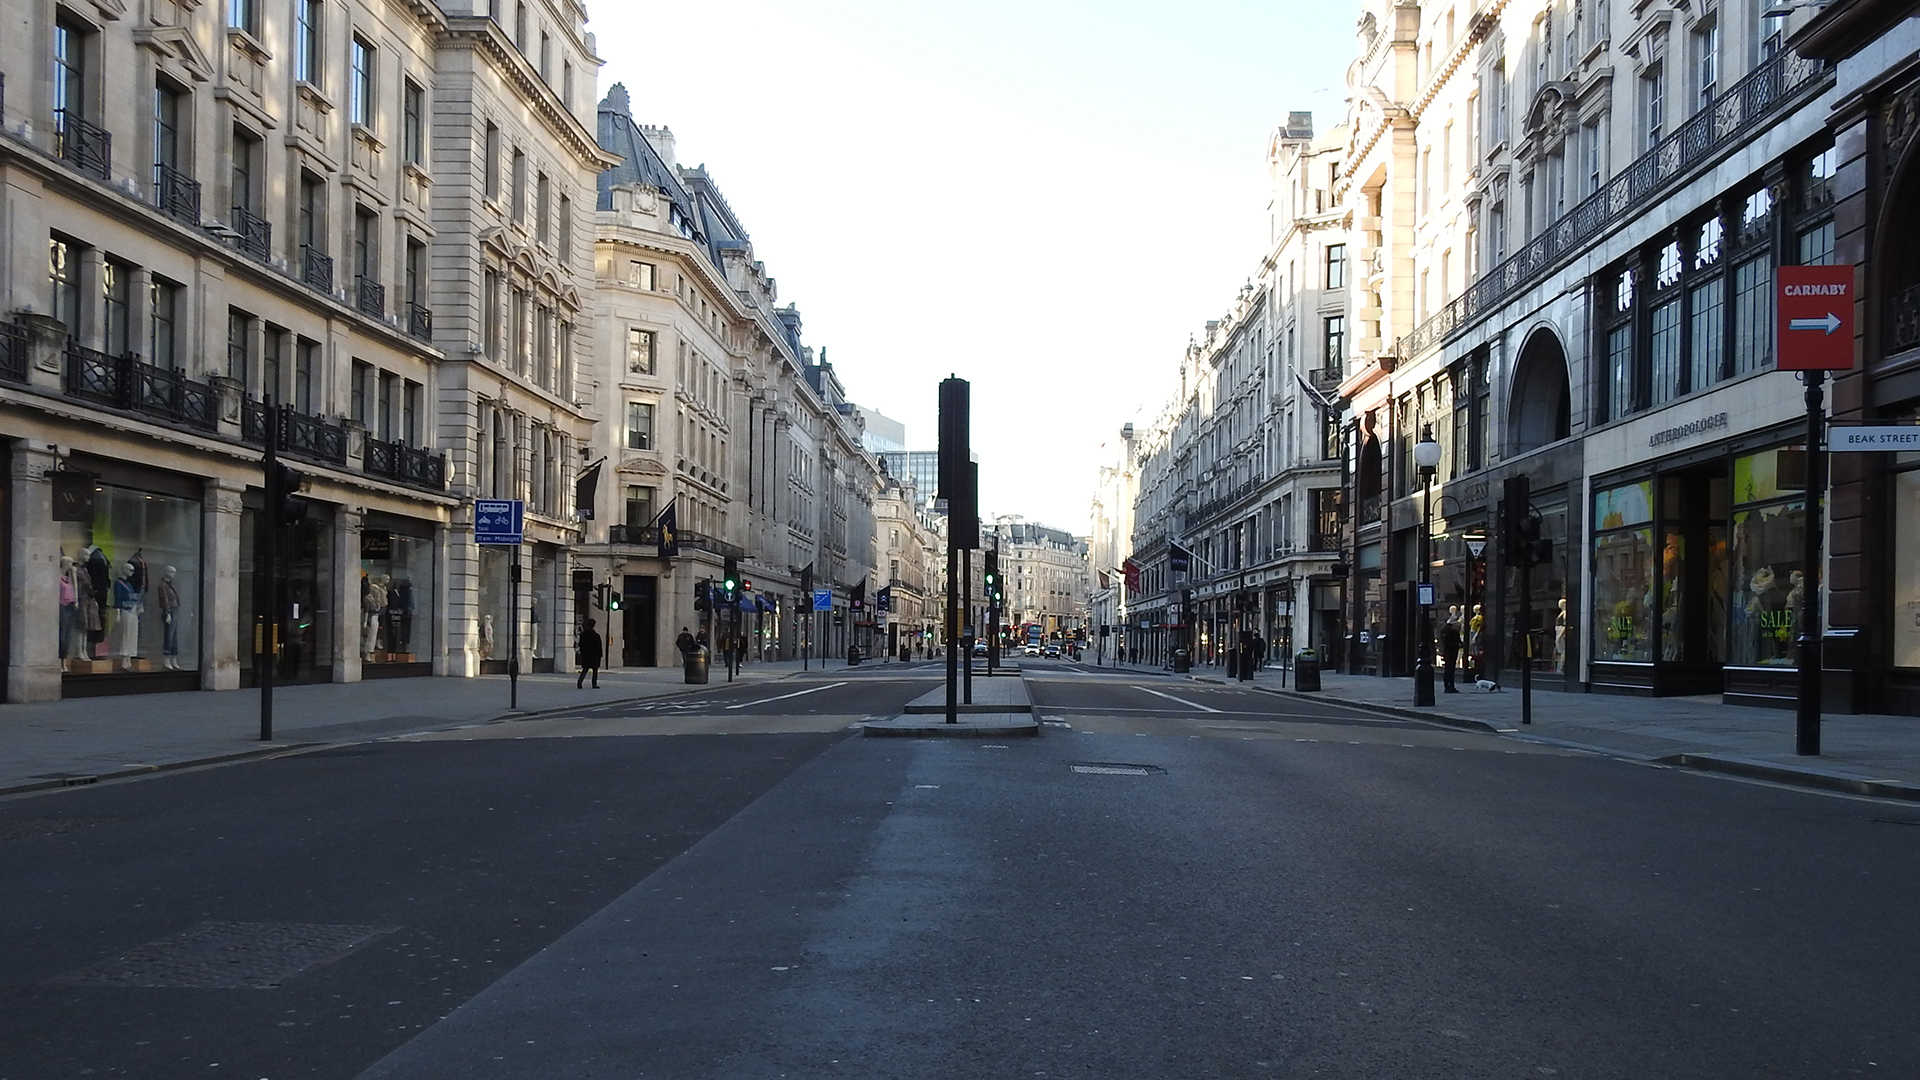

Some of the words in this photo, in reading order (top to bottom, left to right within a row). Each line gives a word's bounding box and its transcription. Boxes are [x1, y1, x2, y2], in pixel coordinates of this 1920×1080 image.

[1784, 284, 1846, 296] CARNABY
[1649, 412, 1727, 447] ANTHROPOLOGIE
[1848, 435, 1875, 444] BEAK
[1880, 434, 1919, 443] STREET
[1611, 616, 1633, 631] SALE
[1761, 610, 1793, 628] SALE
